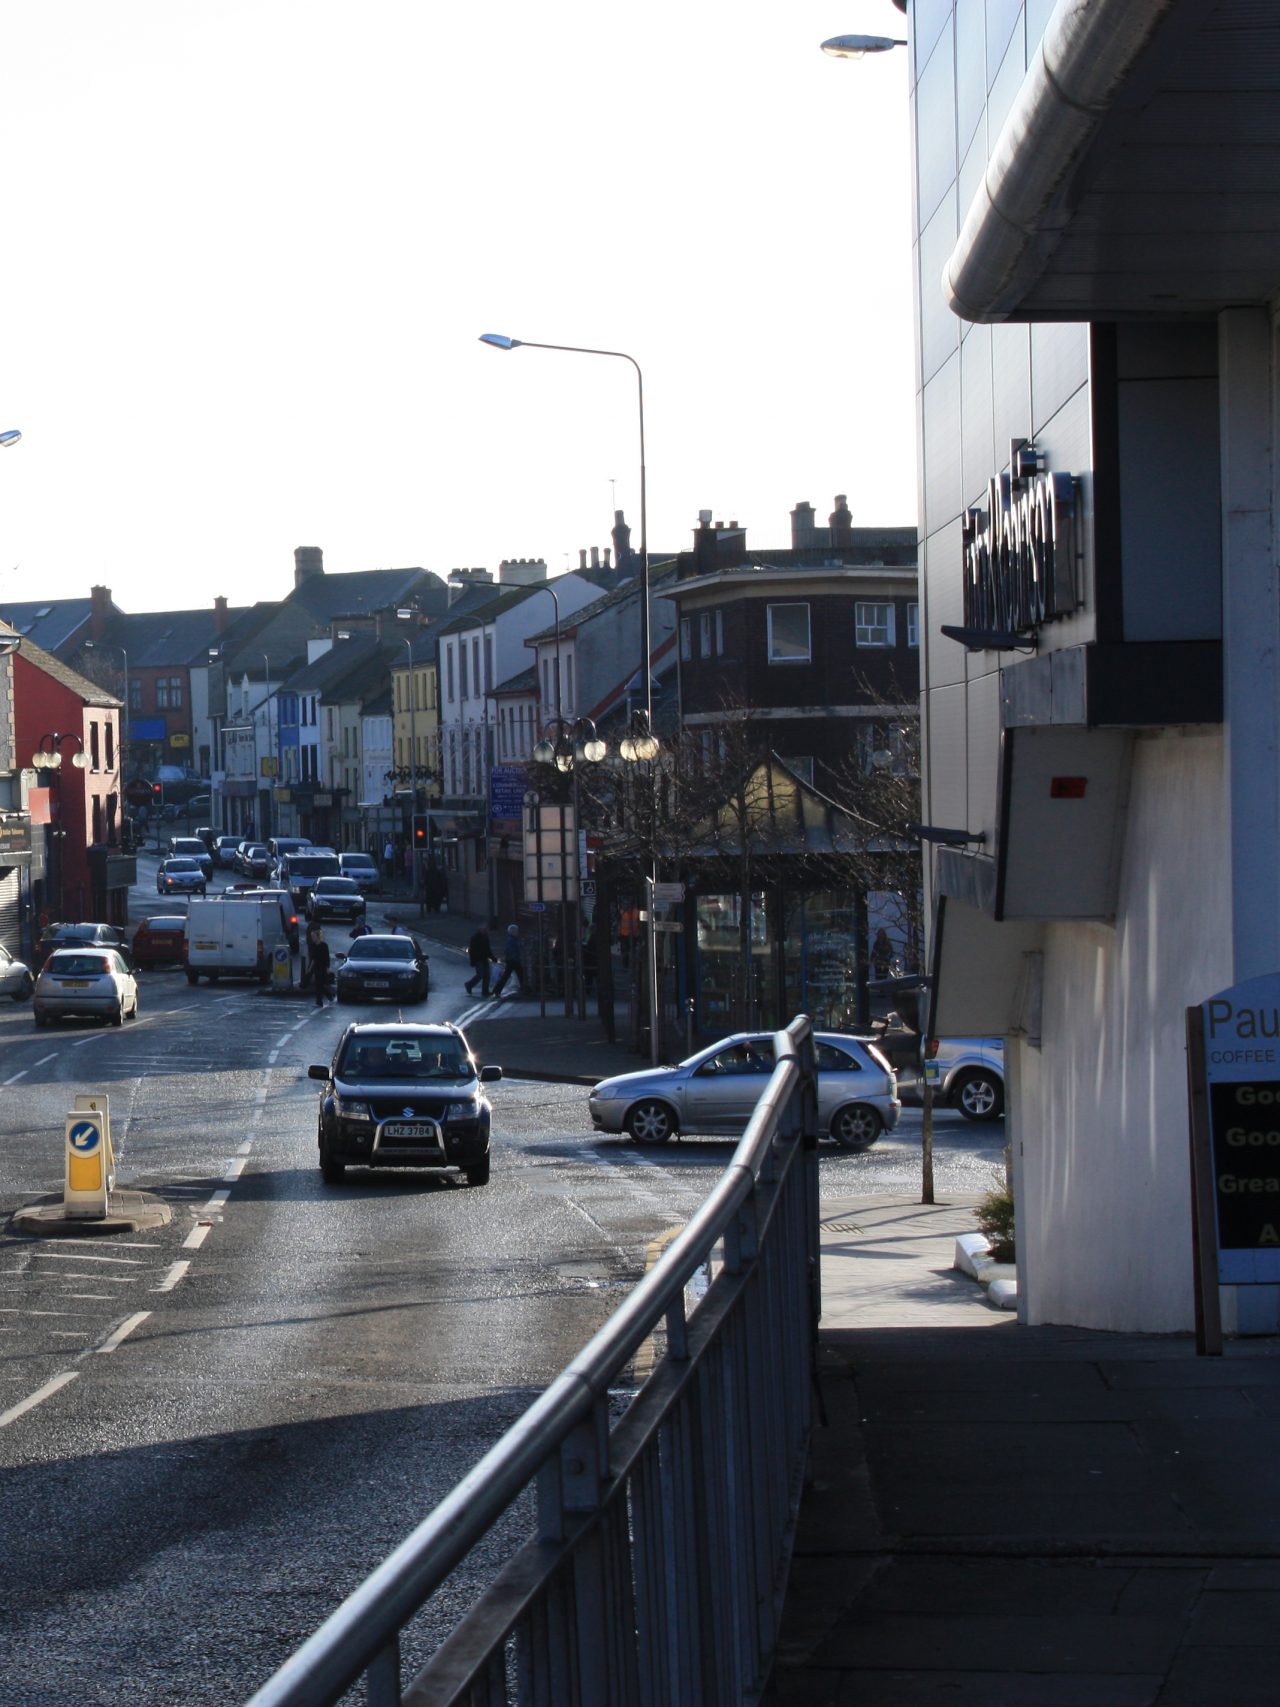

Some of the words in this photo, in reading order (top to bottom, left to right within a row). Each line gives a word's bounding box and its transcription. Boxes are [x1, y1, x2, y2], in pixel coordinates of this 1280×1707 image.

[1211, 1049, 1276, 1064] COFFEE
[387, 1127, 406, 1135] LHZ
[407, 1127, 430, 1135] 3784
[1218, 1174, 1280, 1193] Grea
